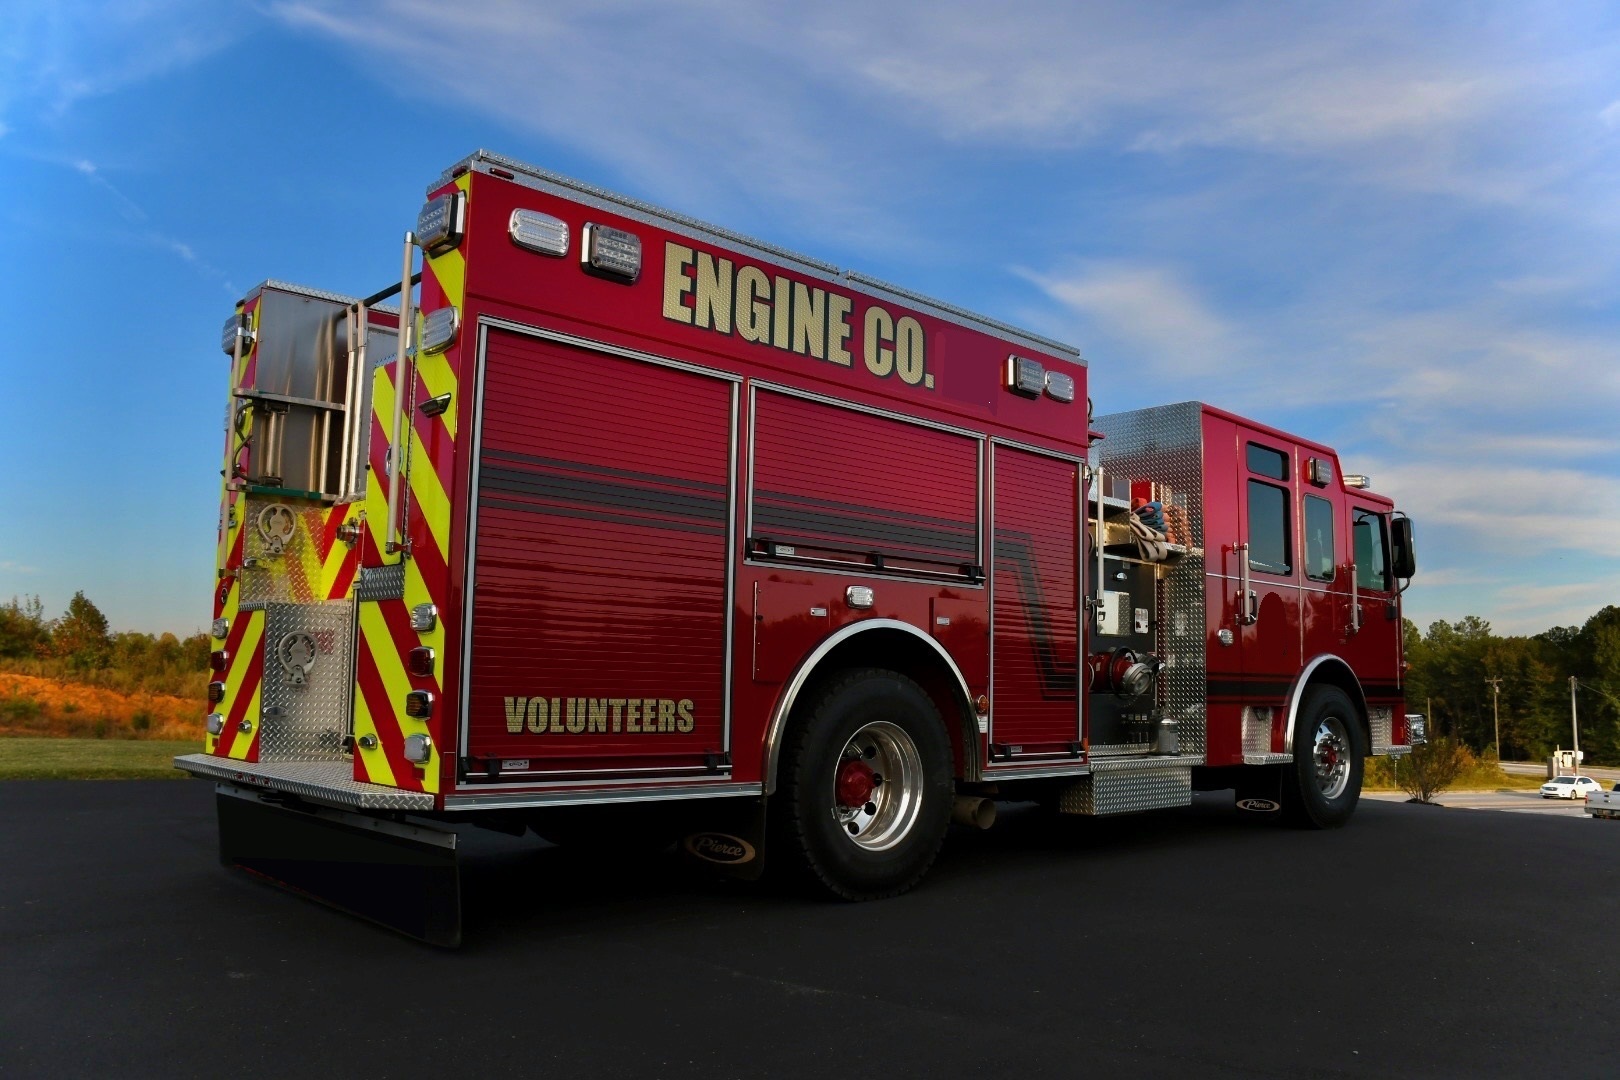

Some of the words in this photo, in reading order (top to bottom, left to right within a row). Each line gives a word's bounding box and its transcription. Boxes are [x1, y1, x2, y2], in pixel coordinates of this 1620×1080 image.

[662, 241, 852, 367] ENGINE
[863, 306, 935, 389] CO.
[503, 696, 695, 733] VOLUNTEERS
[695, 837, 743, 856] Pierce
